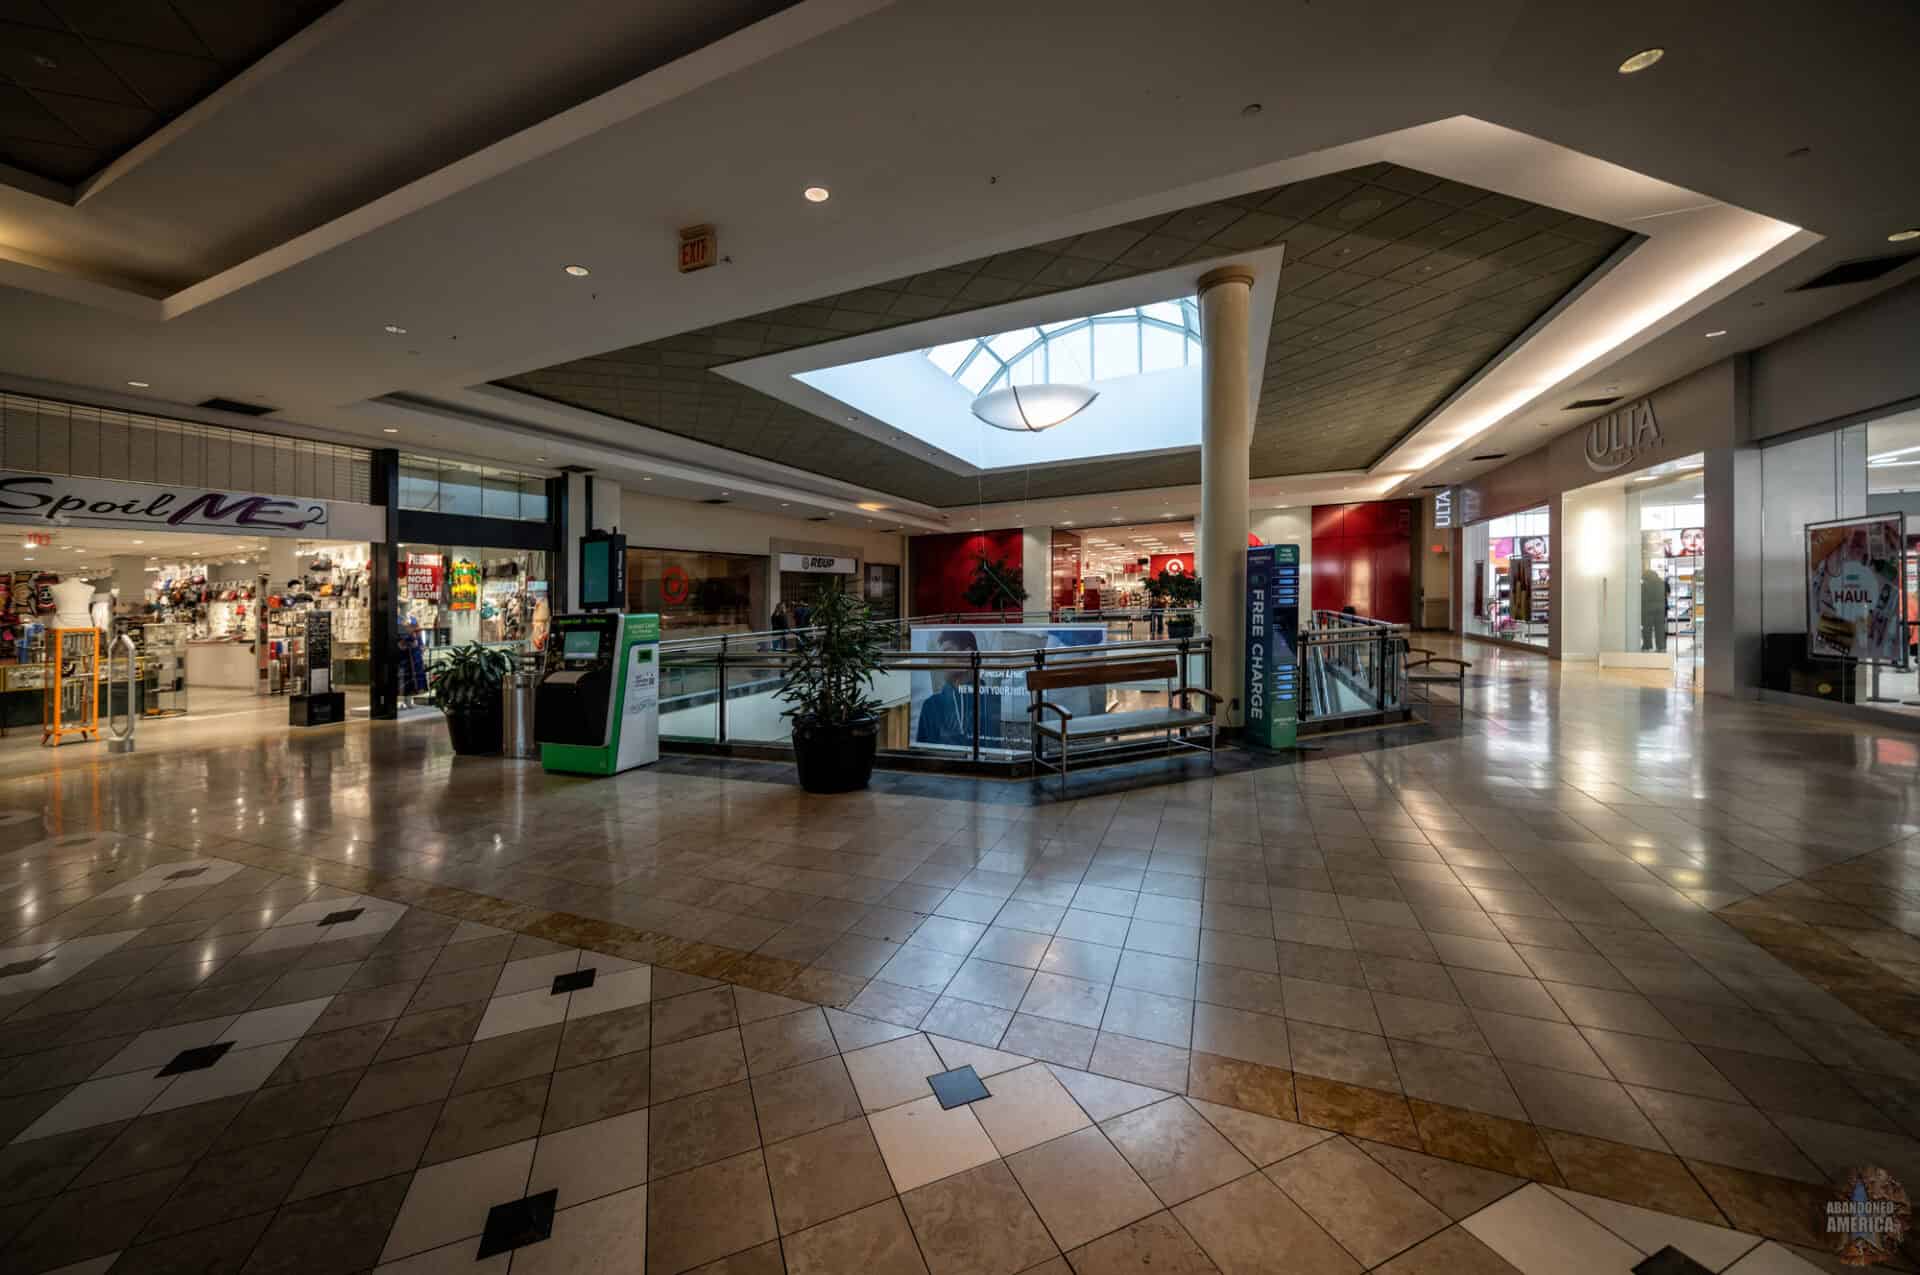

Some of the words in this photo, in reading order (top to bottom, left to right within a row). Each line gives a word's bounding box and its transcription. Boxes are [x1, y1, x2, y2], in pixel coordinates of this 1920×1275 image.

[1590, 398, 1661, 458] ULTA
[0, 477, 176, 519] Spoil
[1435, 490, 1451, 527] ULTA
[408, 576, 433, 584] NOSE
[1834, 590, 1872, 603] HAUL
[1252, 589, 1265, 637] FREE
[1250, 643, 1264, 720] CHARGE
